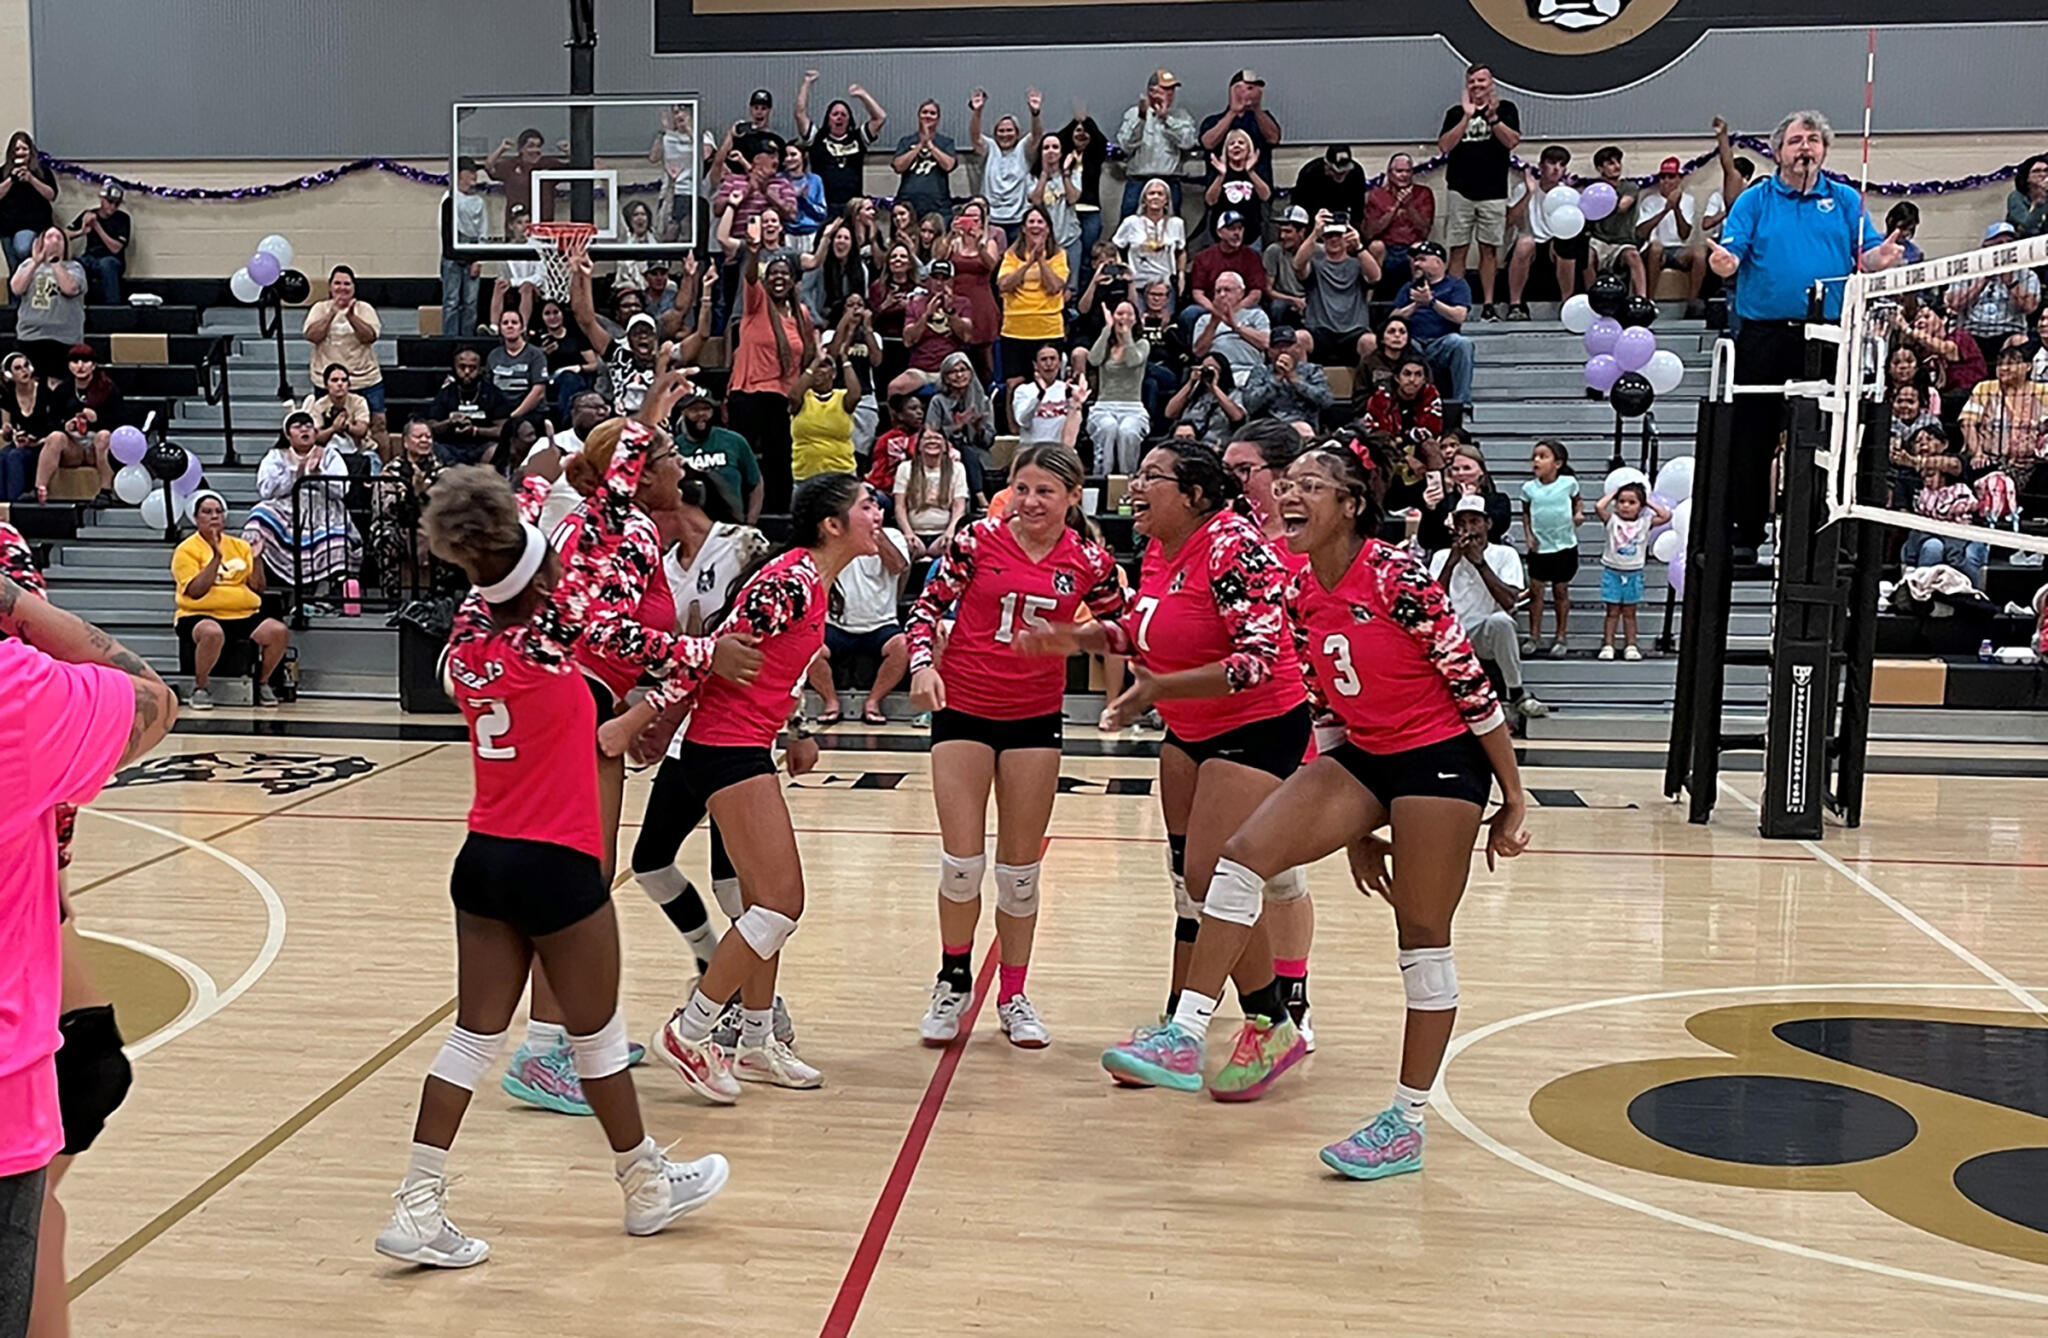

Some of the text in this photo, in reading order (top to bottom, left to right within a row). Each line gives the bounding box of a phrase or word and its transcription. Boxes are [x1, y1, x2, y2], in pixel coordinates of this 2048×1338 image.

[994, 592, 1057, 644] 15
[1135, 595, 1159, 651] 7
[1323, 633, 1361, 696] 3
[467, 697, 517, 759] 2
